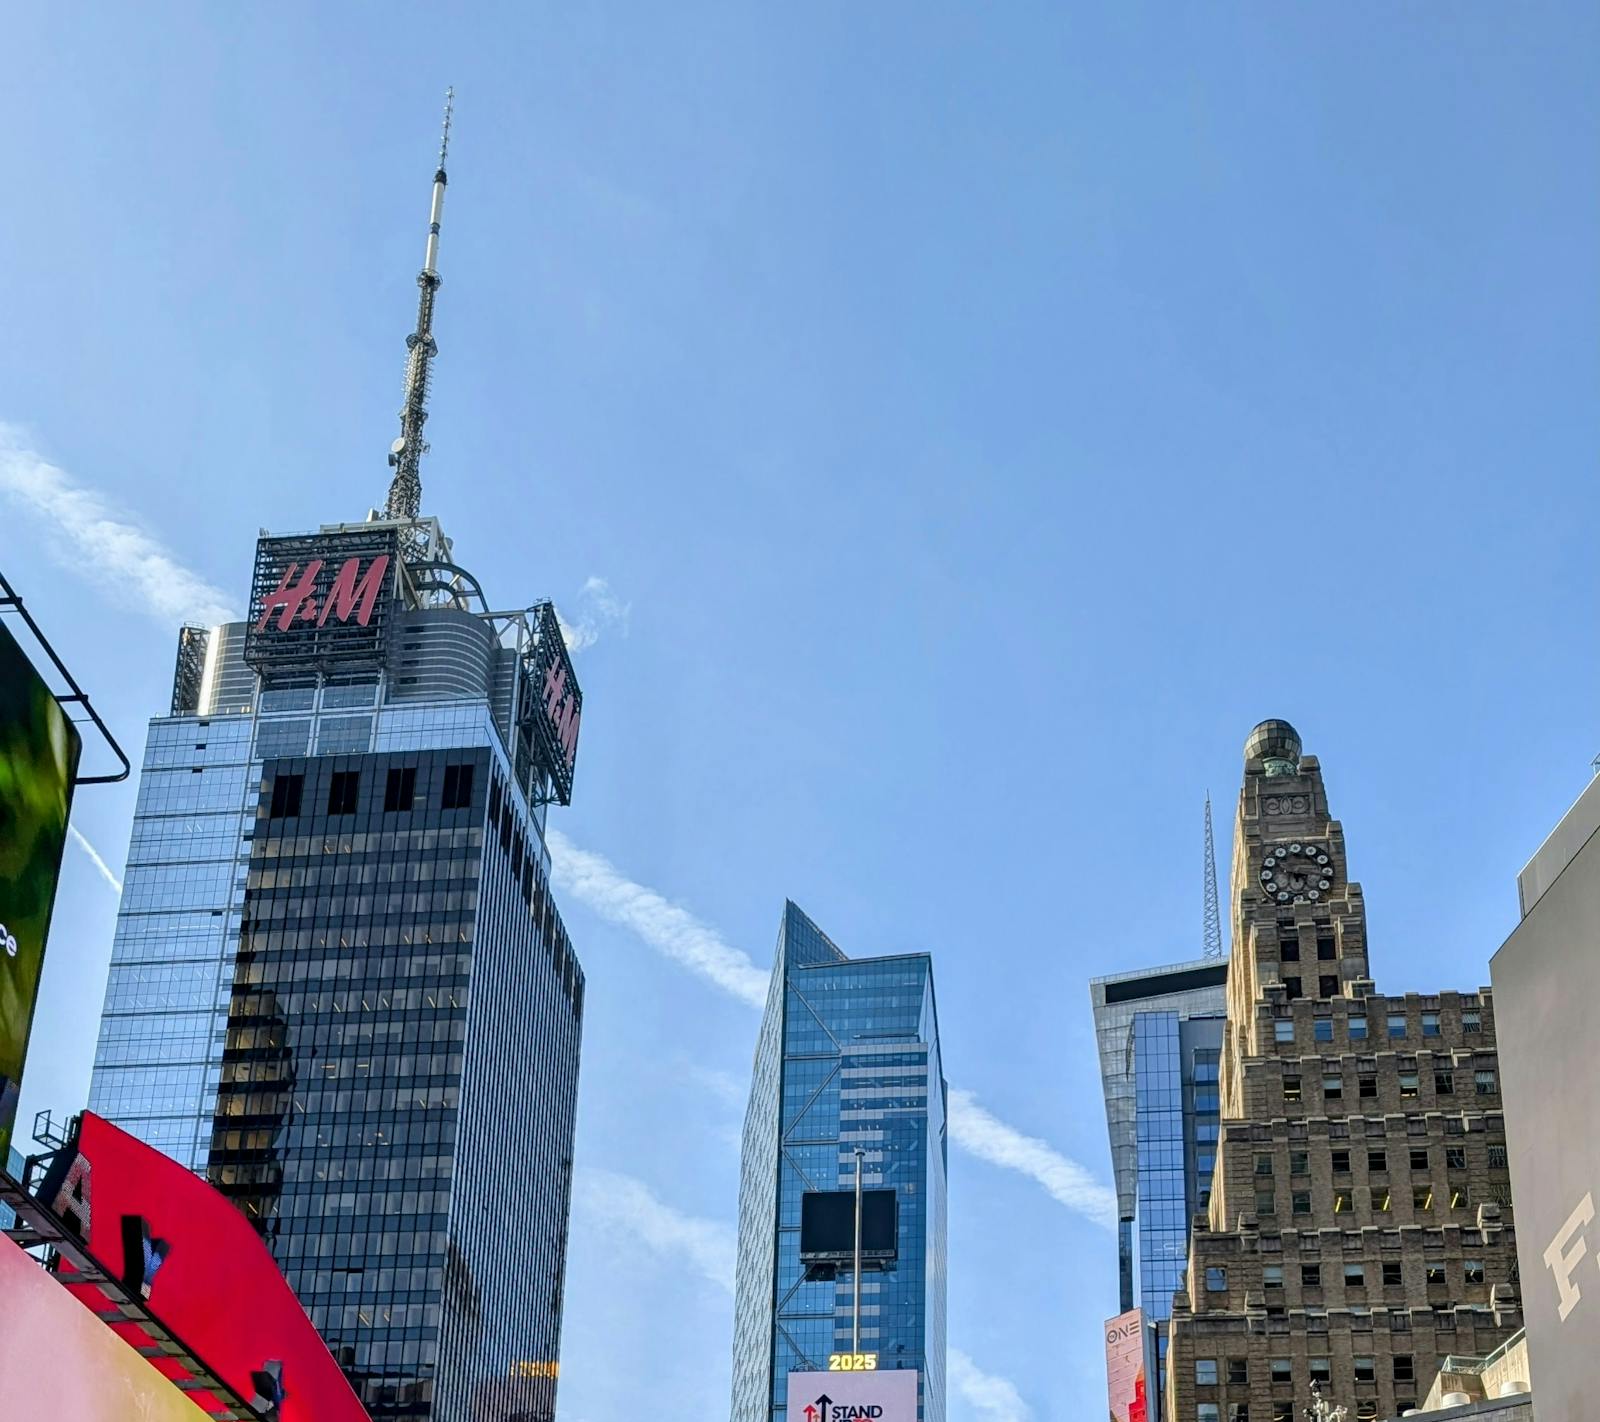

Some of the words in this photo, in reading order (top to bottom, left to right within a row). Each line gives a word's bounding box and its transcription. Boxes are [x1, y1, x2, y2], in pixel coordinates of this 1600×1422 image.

[257, 554, 390, 633] H&M
[542, 655, 580, 769] H&M
[828, 1354, 877, 1371] 2025
[831, 1405, 883, 1420] STAND
